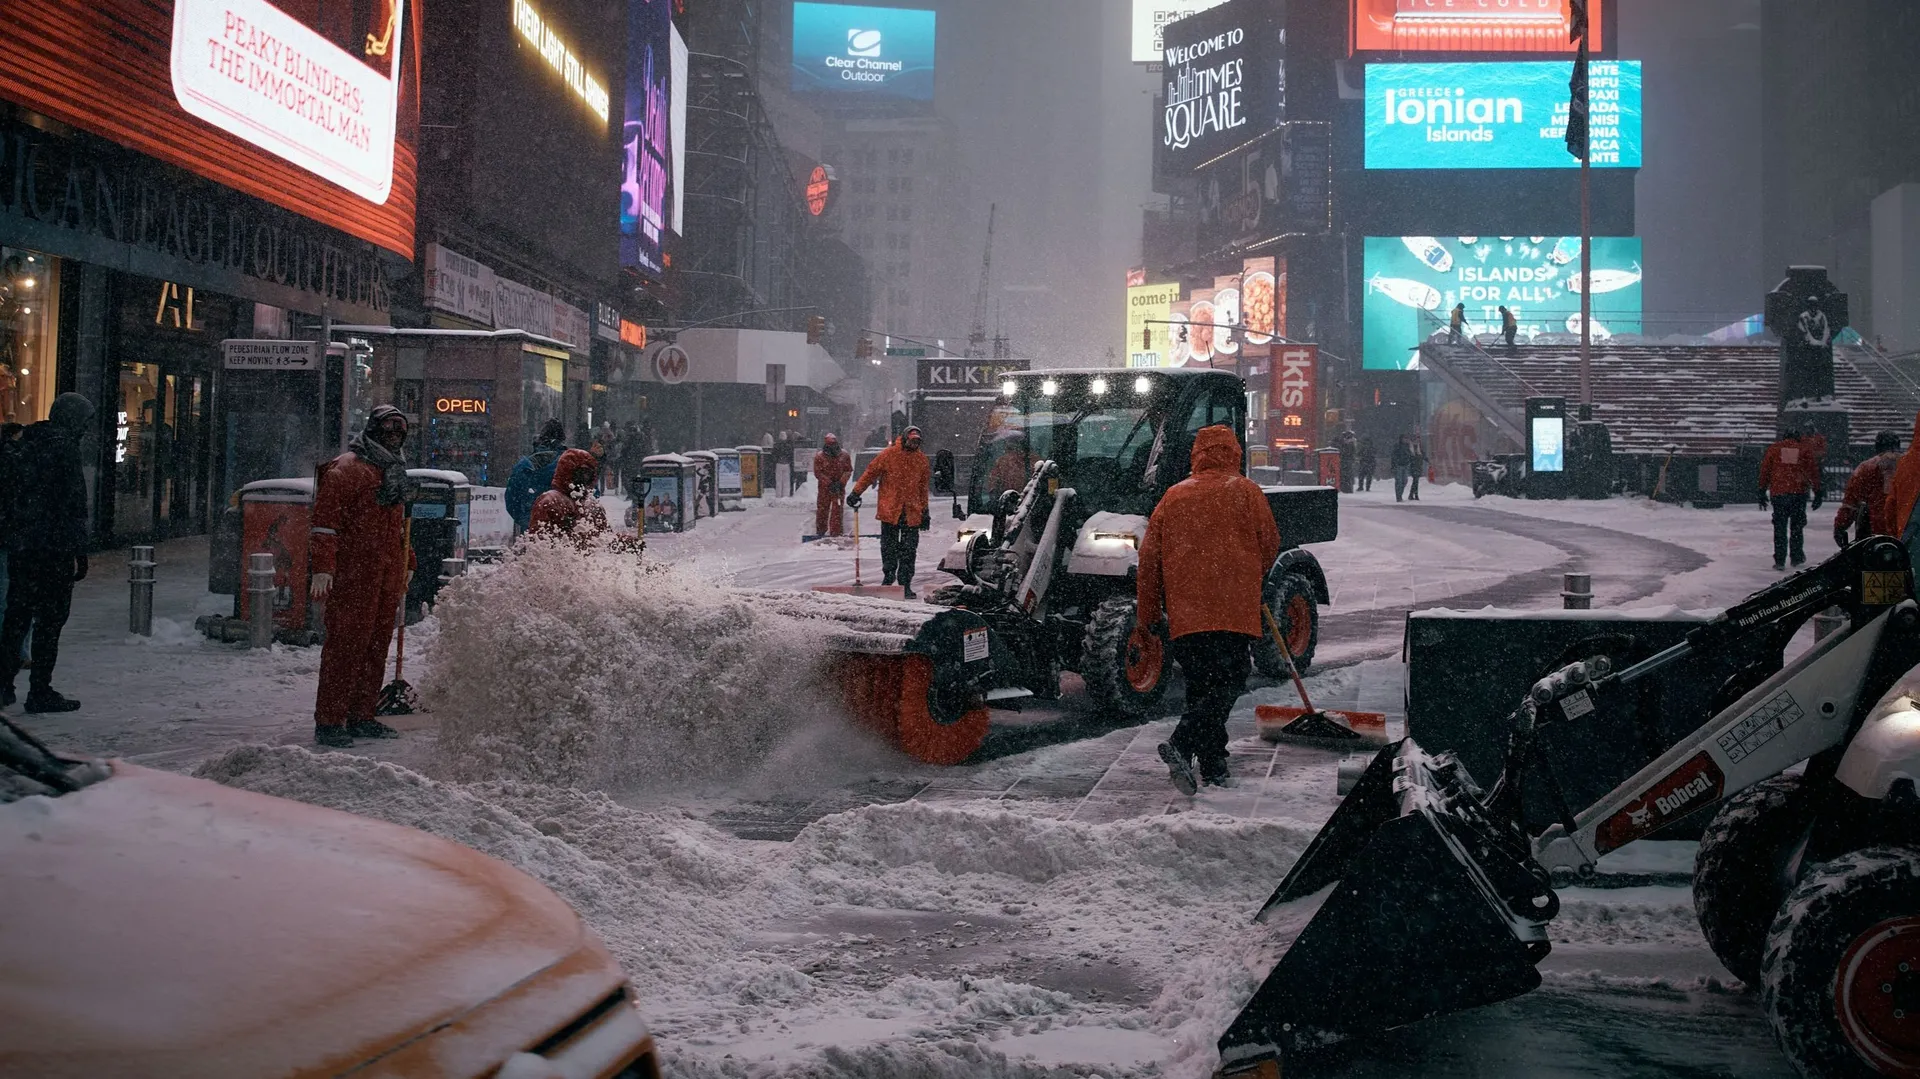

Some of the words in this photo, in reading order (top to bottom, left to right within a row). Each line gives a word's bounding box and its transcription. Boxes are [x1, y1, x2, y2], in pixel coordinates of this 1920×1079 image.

[1166, 35, 1225, 67] WELCOME
[1227, 28, 1244, 47] TO
[223, 10, 283, 67] PEAKY
[283, 46, 364, 116] BLINDERS:
[540, 21, 565, 75] LIGHT
[564, 49, 585, 98] STILL
[825, 56, 855, 68] Clear
[857, 58, 902, 71] Channel
[841, 70, 885, 82] Outdoor
[1197, 58, 1244, 96] TIMES
[208, 38, 245, 84] THE
[248, 61, 336, 134] IMMORTAL
[337, 112, 372, 152] MAN
[1399, 88, 1451, 97] GREECE
[1385, 87, 1523, 125] Ionian
[1554, 103, 1619, 113] LEADA
[1551, 114, 1619, 126] MENISI
[1427, 125, 1494, 142] Islands
[1540, 127, 1619, 138] KEFONIA
[1459, 267, 1545, 282] ISLANDS
[1132, 293, 1167, 307] come
[1460, 286, 1501, 301] FOR
[1507, 286, 1545, 301] ALL
[229, 344, 270, 354] PEDESTRIAN
[272, 345, 290, 354] FLOW
[291, 345, 309, 354] ZONE
[229, 356, 246, 365] KEEP
[248, 356, 273, 365] MOVING
[1281, 350, 1312, 409] tkts
[436, 398, 486, 413] OPEN
[1738, 614, 1759, 628] High
[1758, 604, 1780, 618] Flow
[1779, 583, 1823, 609] Hydraulics
[1654, 771, 1714, 816] Bobcat
